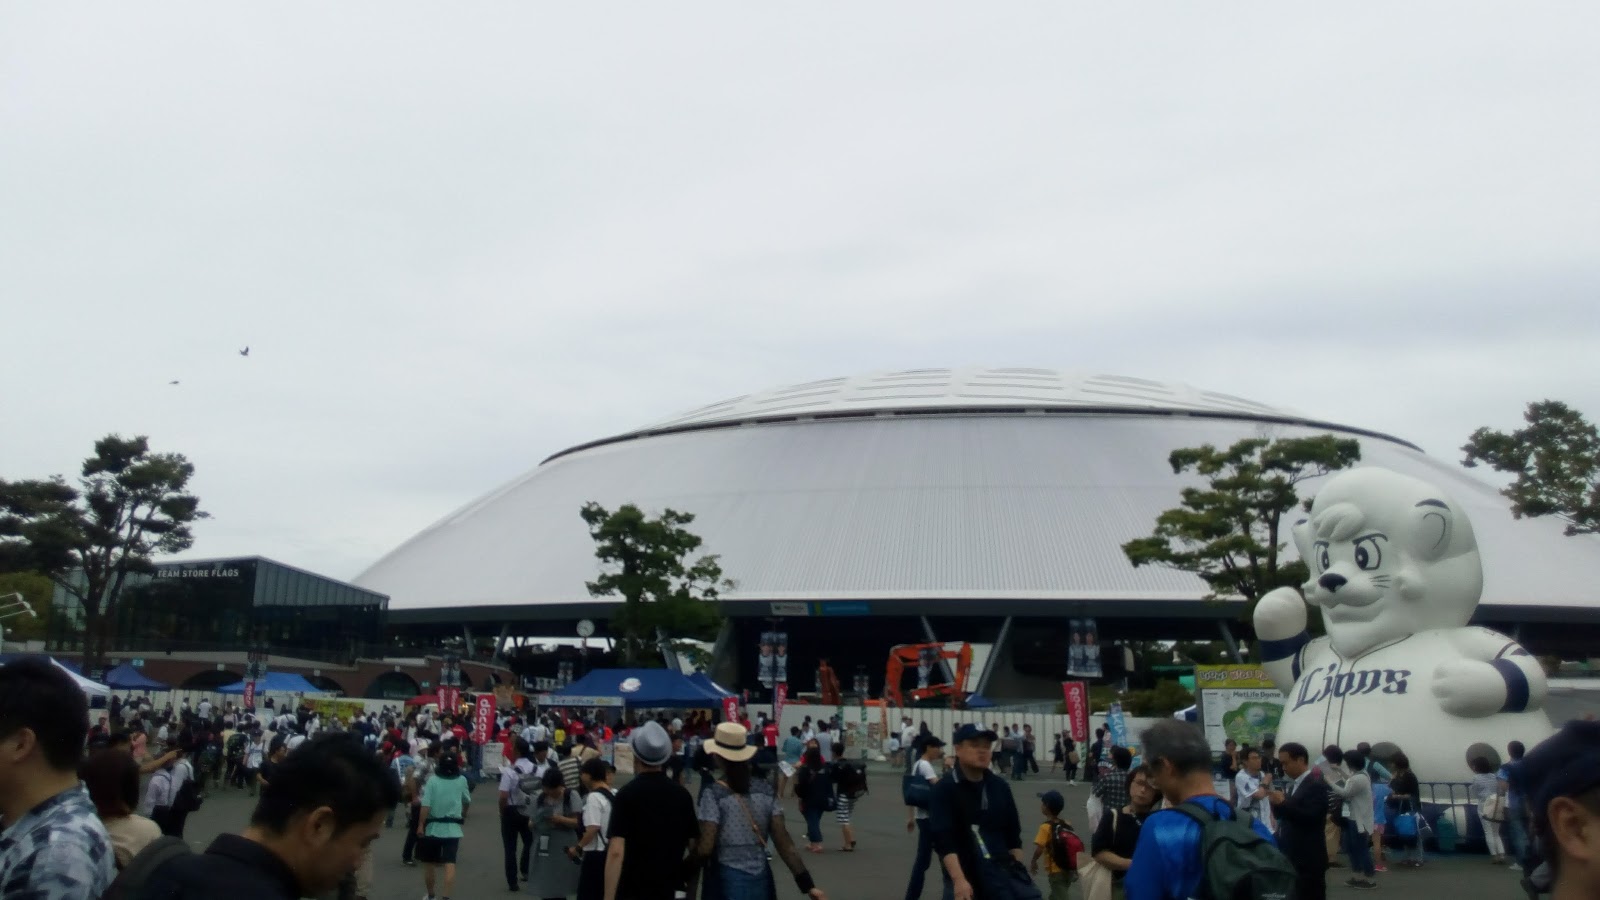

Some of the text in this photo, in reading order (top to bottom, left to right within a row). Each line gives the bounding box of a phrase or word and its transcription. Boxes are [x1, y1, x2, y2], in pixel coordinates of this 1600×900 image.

[157, 568, 239, 578] TEAM STORE FLAGS
[1291, 663, 1411, 712] Lions
